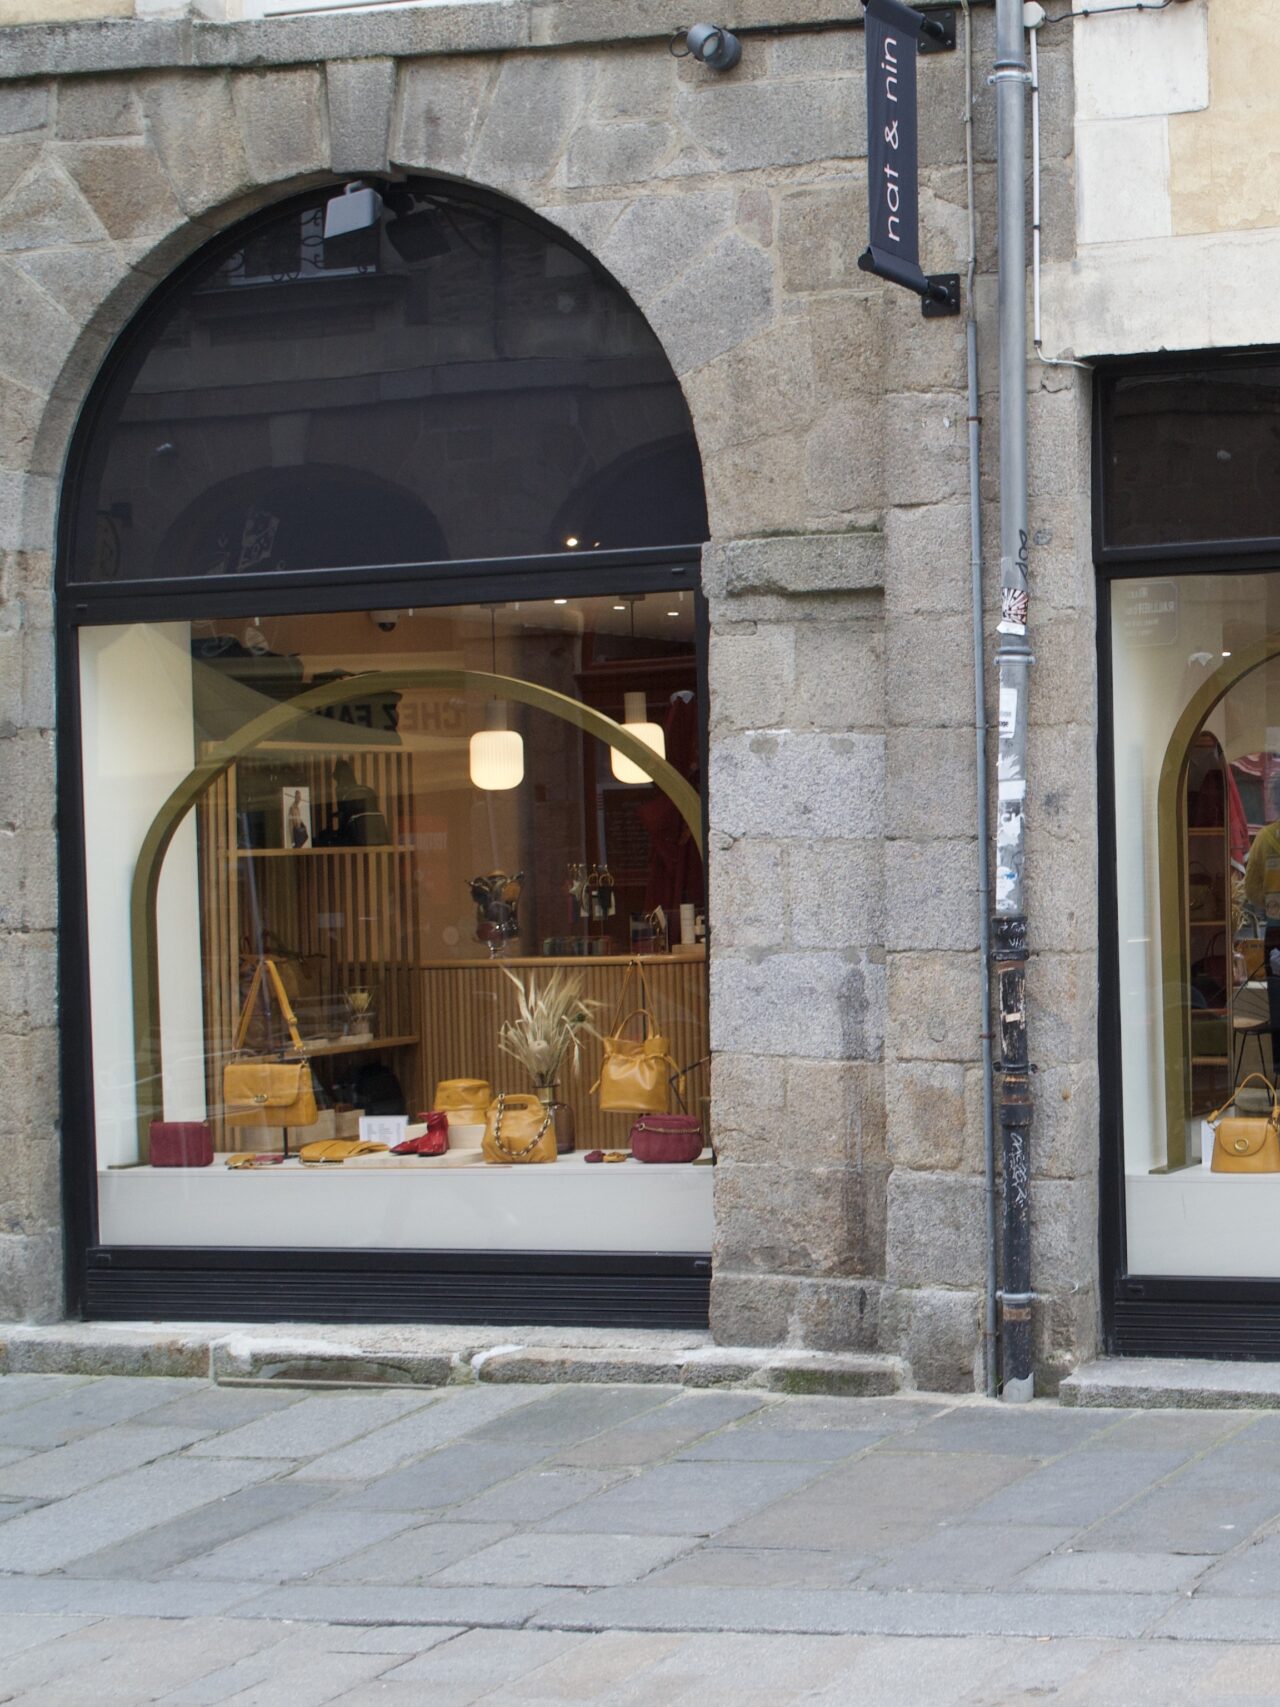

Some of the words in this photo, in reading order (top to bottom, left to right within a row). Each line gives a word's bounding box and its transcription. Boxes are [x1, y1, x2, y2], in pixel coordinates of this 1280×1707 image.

[881, 37, 898, 103] nin
[884, 120, 899, 150] &
[884, 163, 900, 242] nat
